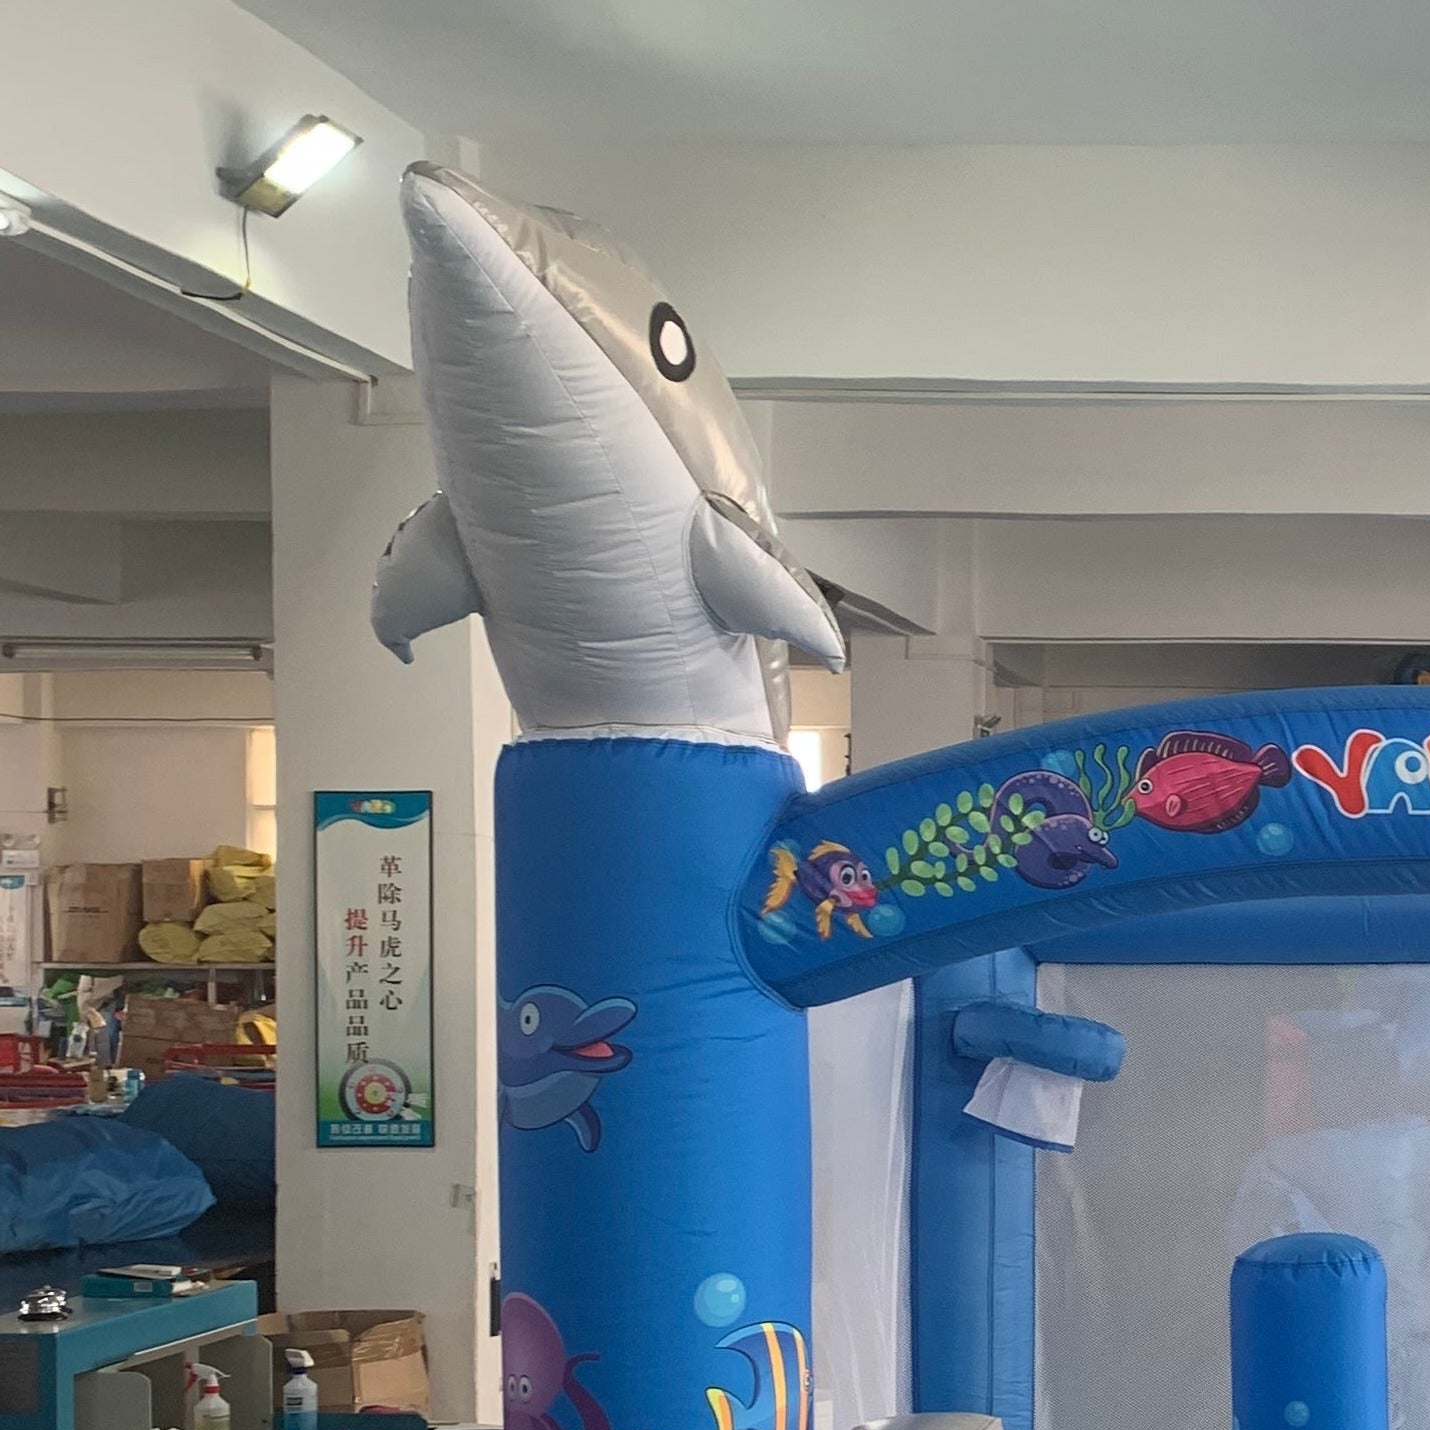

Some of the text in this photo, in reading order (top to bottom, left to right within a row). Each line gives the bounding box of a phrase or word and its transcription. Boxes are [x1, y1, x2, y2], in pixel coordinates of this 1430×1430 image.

[344, 908, 369, 1064] 提升产品品质
[377, 855, 402, 1010] 革除马虎之心
